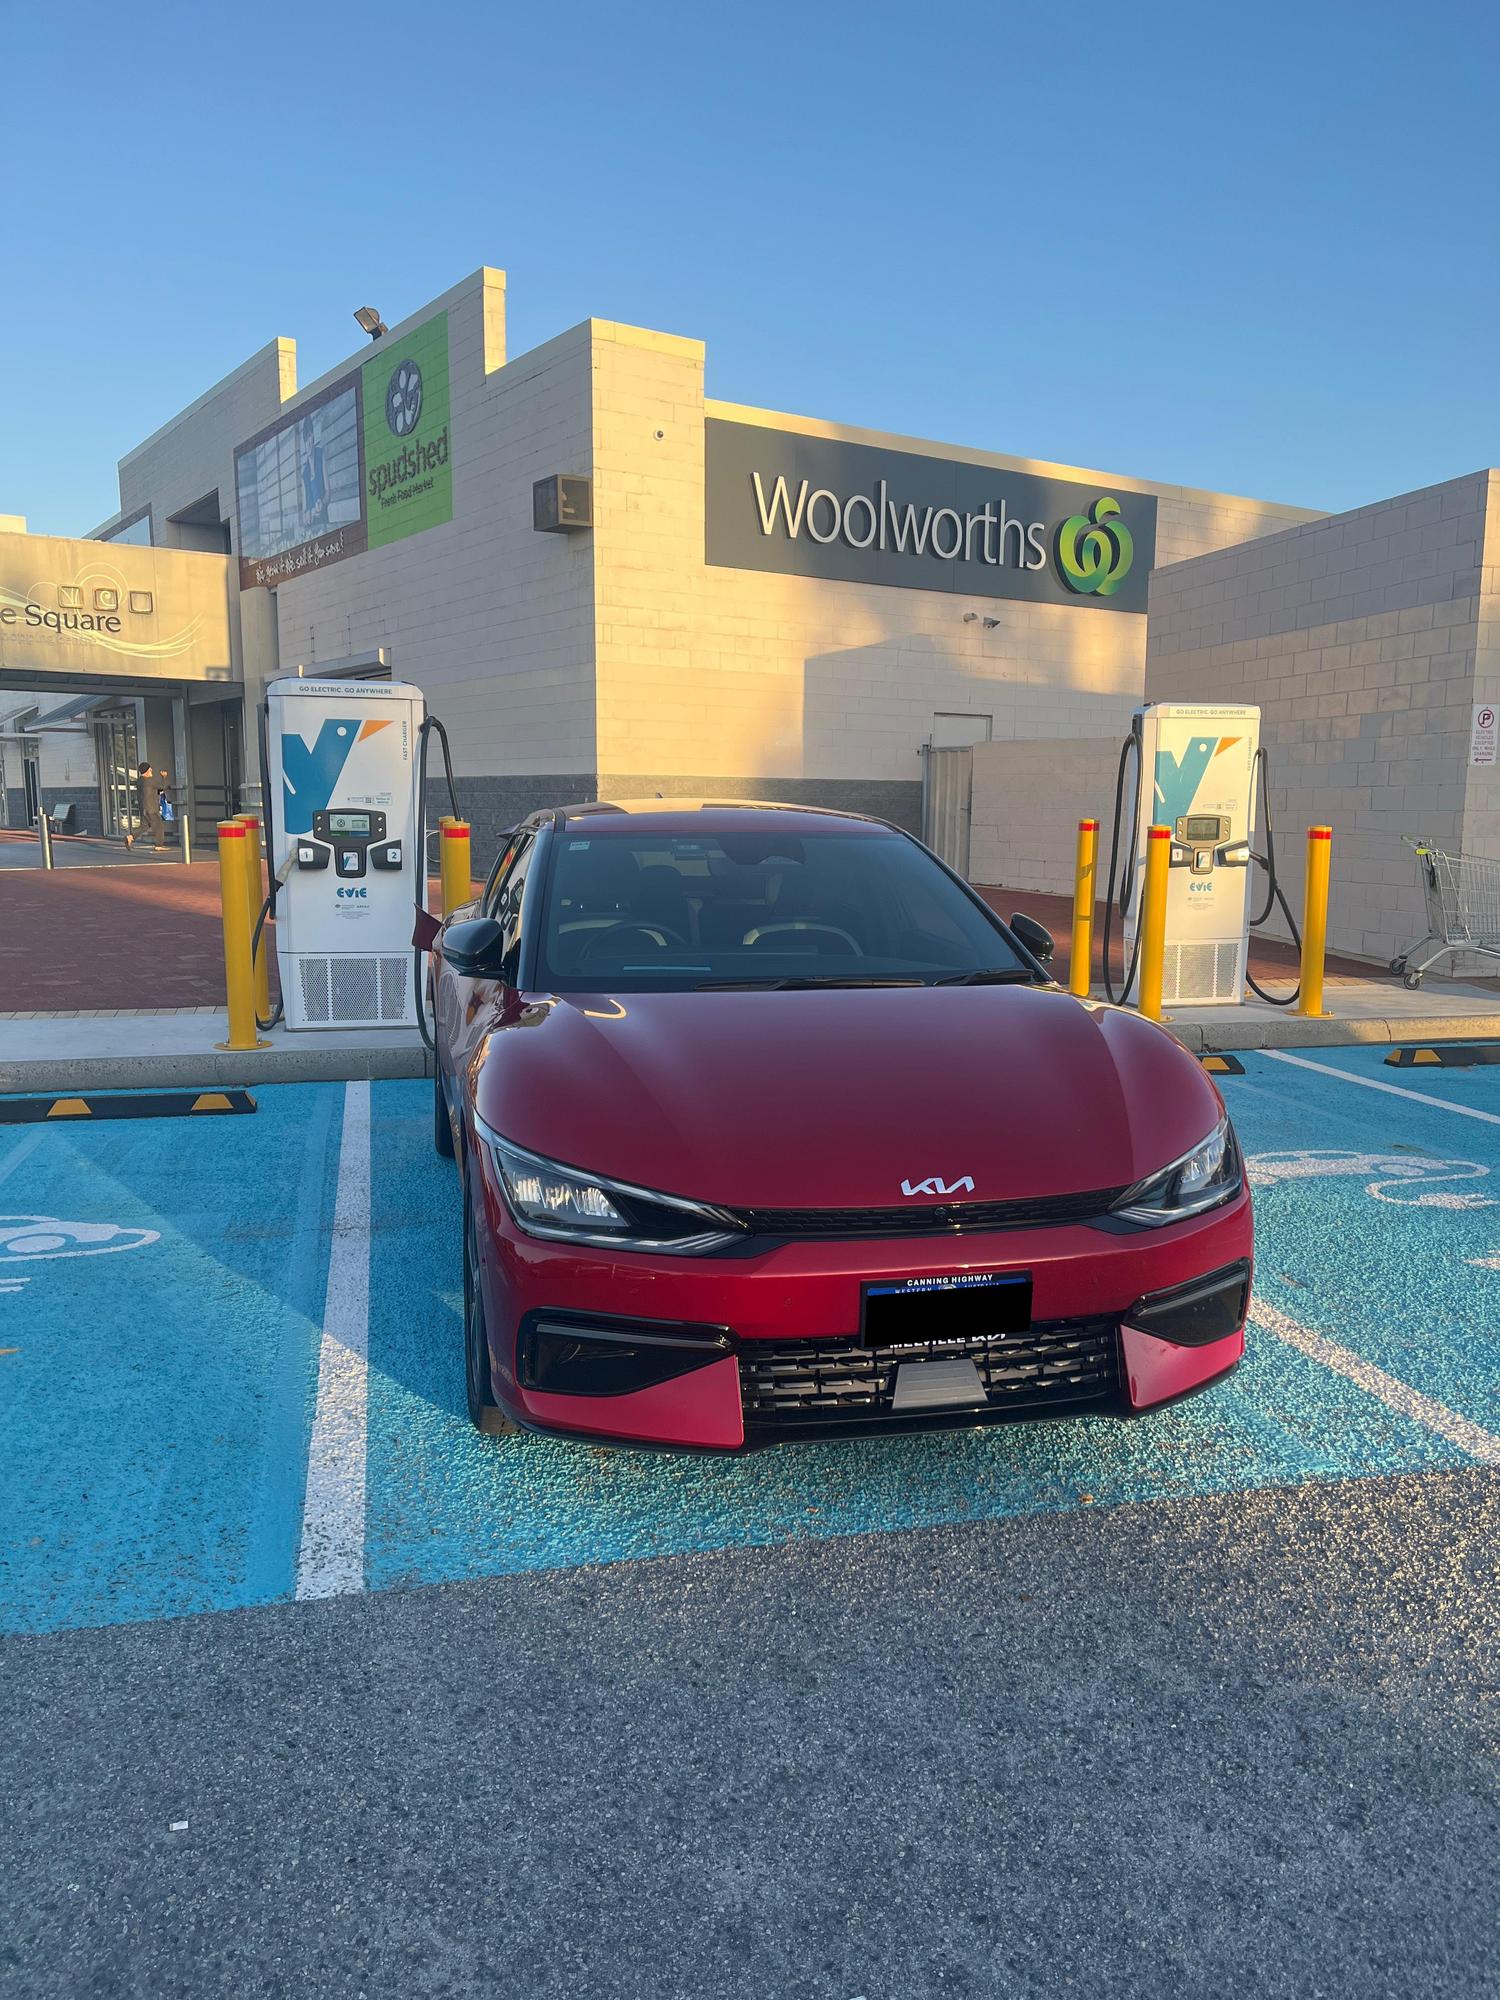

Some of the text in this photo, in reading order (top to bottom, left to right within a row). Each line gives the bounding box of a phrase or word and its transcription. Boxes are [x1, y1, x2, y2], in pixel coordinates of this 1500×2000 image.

[368, 426, 449, 500] spudshed
[749, 471, 1047, 571] Woolworths
[24, 604, 122, 634] Square
[356, 687, 393, 695] ANYWHERE
[900, 1175, 976, 1196] KIA
[906, 1274, 993, 1287] CANNING HIGHWAY
